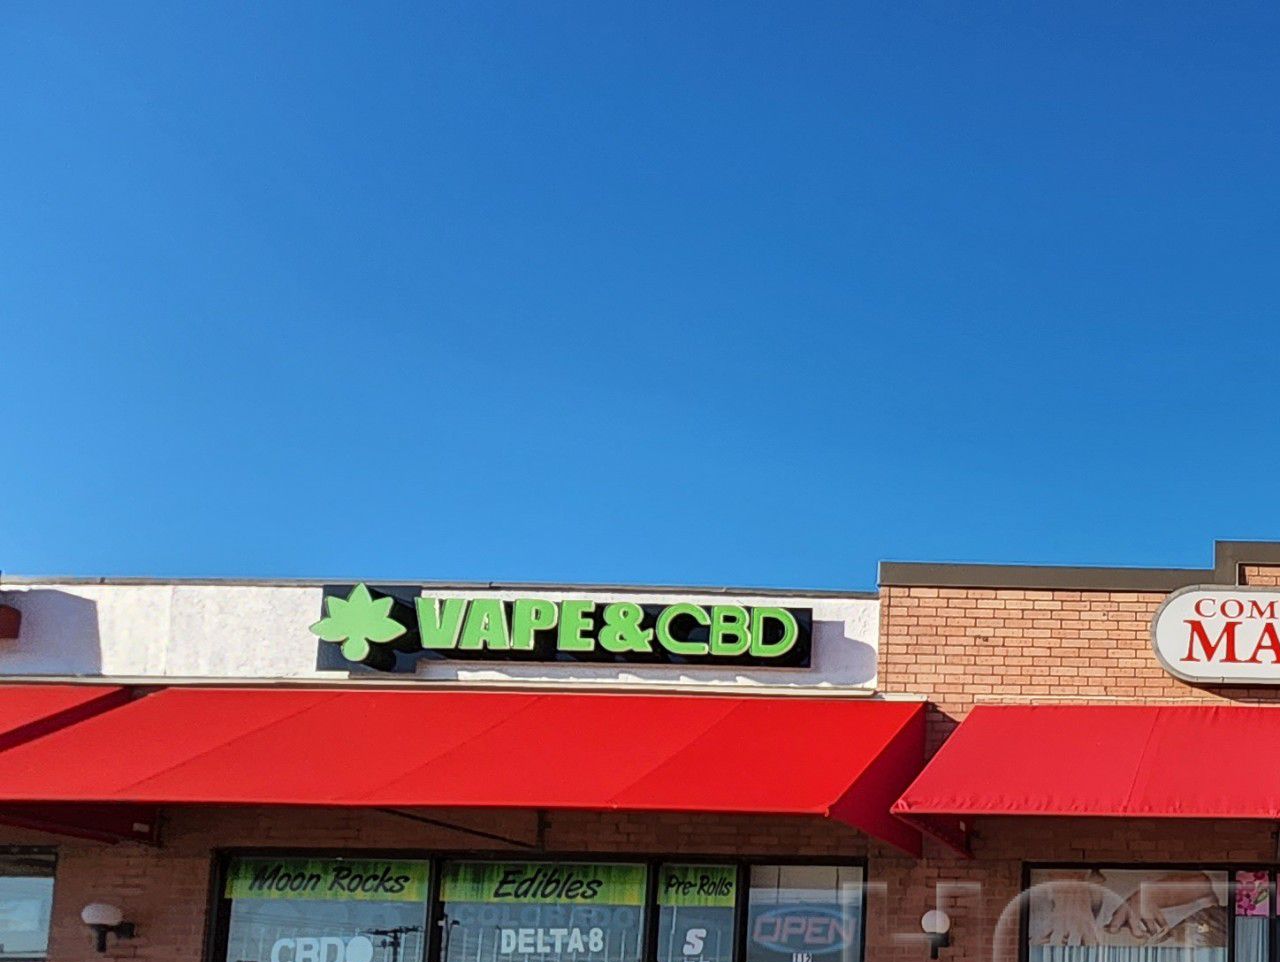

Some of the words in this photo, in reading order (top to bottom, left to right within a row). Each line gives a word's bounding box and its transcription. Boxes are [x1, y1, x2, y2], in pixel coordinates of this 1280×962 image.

[248, 864, 321, 893] Moon
[327, 866, 411, 894] Rocks
[493, 867, 604, 900] Edibles
[752, 913, 858, 946] OPEN
